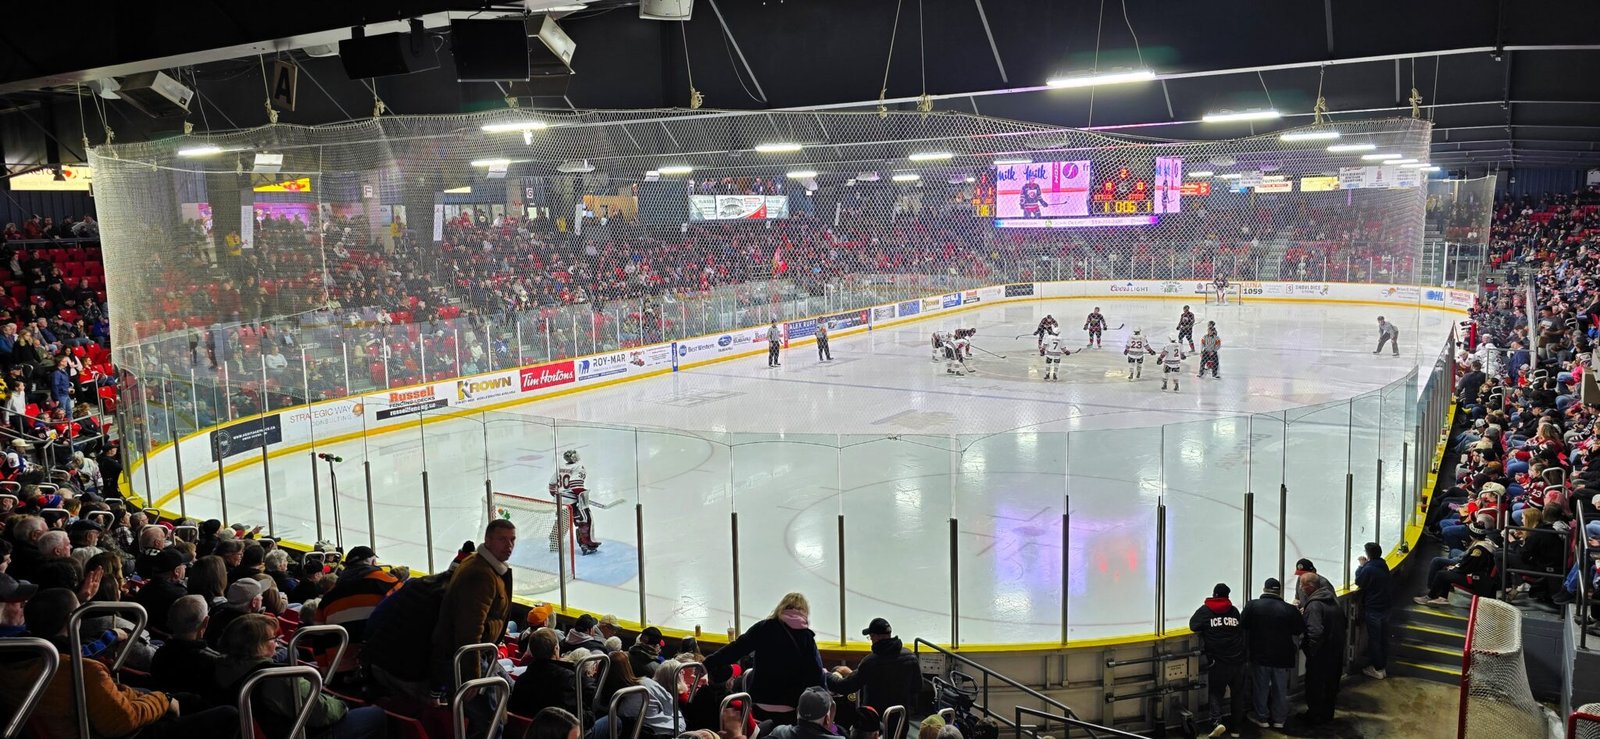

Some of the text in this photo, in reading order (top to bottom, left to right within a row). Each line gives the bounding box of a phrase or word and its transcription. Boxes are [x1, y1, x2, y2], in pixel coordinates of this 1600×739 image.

[274, 66, 292, 105] A
[365, 186, 372, 196] F
[1131, 341, 1142, 349] 23
[593, 354, 626, 367] ROY-MAR
[522, 373, 540, 388] Tim
[540, 370, 574, 385] Hortons
[457, 376, 512, 401] KROWN
[389, 386, 435, 403] Russell
[334, 405, 352, 415] WAY
[1531, 488, 1542, 498] 23
[1210, 618, 1223, 627] ICE
